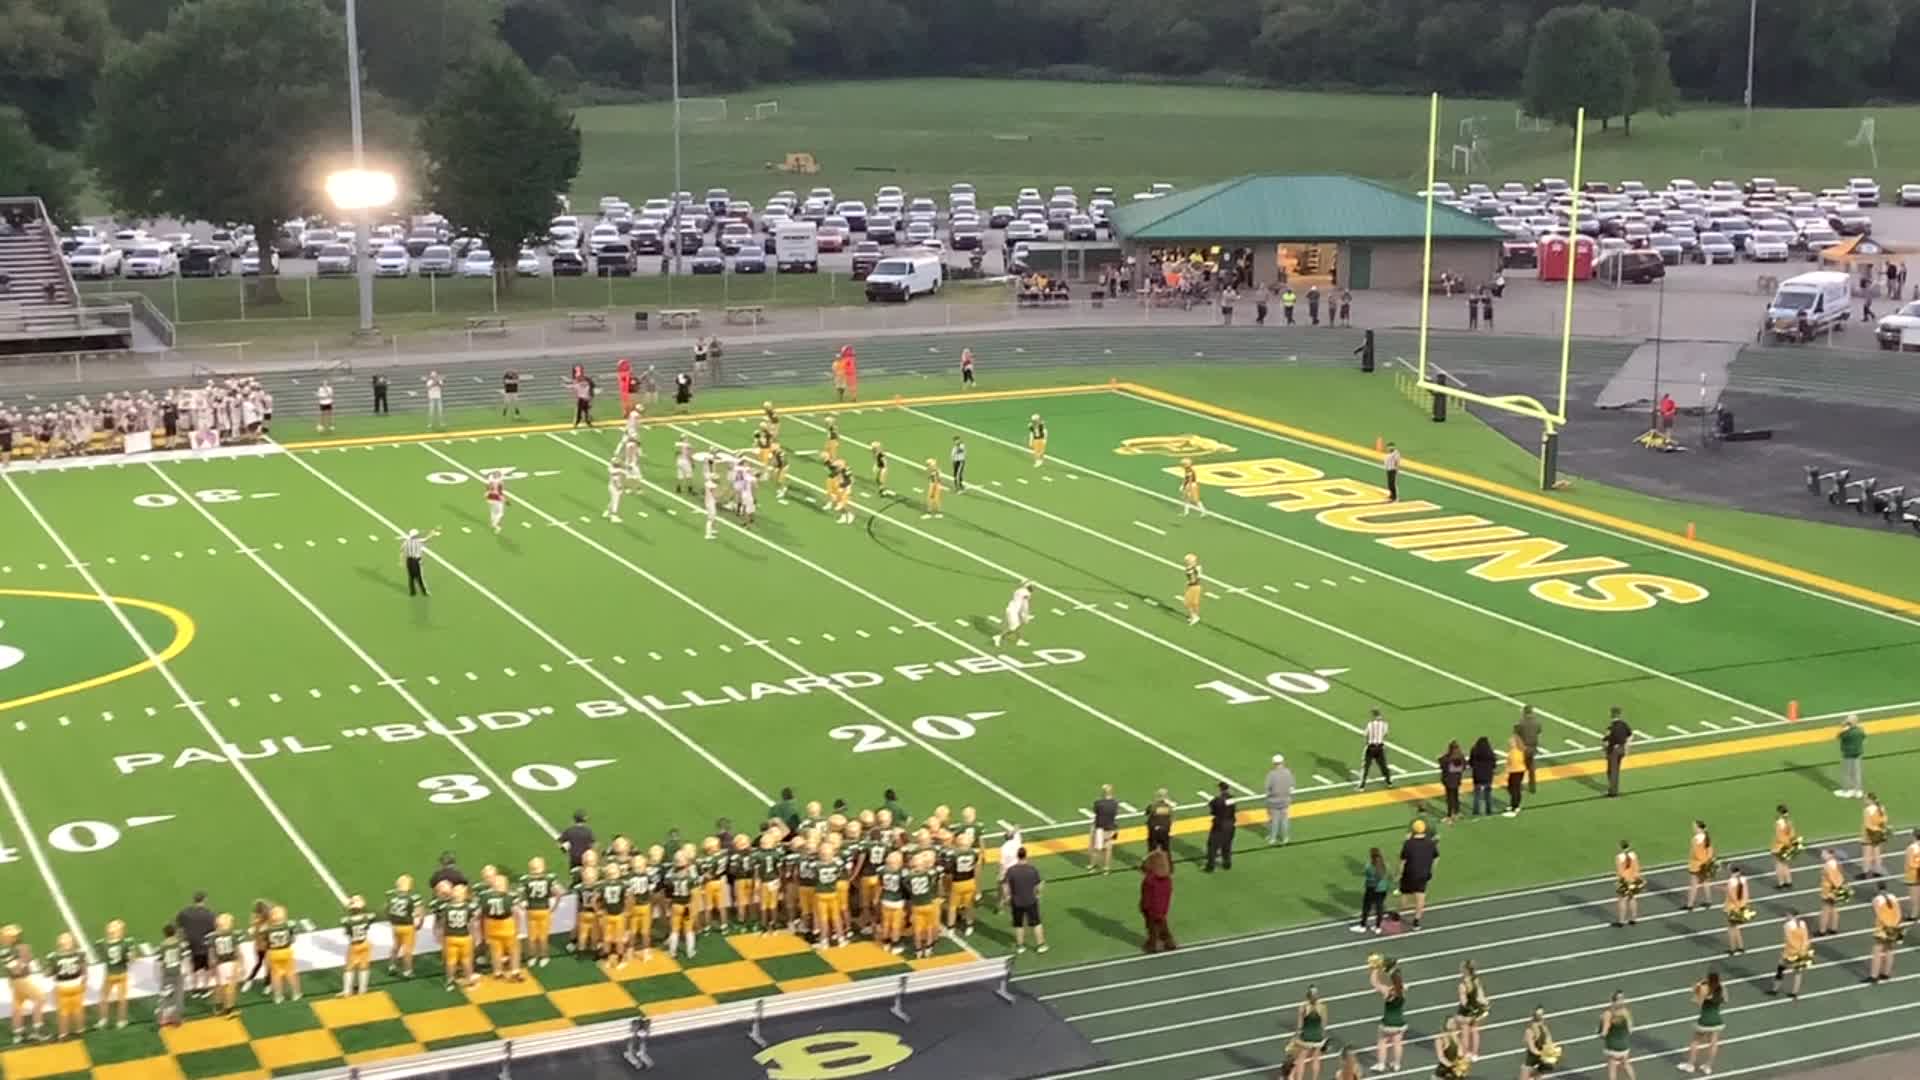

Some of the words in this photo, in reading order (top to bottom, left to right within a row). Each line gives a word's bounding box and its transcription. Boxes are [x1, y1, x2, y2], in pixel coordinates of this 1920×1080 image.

[1161, 458, 1709, 611] BRUINS
[1194, 672, 1330, 704] 10
[113, 736, 333, 774] PAUL
[342, 706, 555, 742] "BUD"
[576, 671, 884, 718] BILLIARD
[893, 648, 1087, 681] FIELD
[828, 715, 976, 752] 20
[417, 763, 578, 804] 30
[753, 1030, 914, 1080] B
